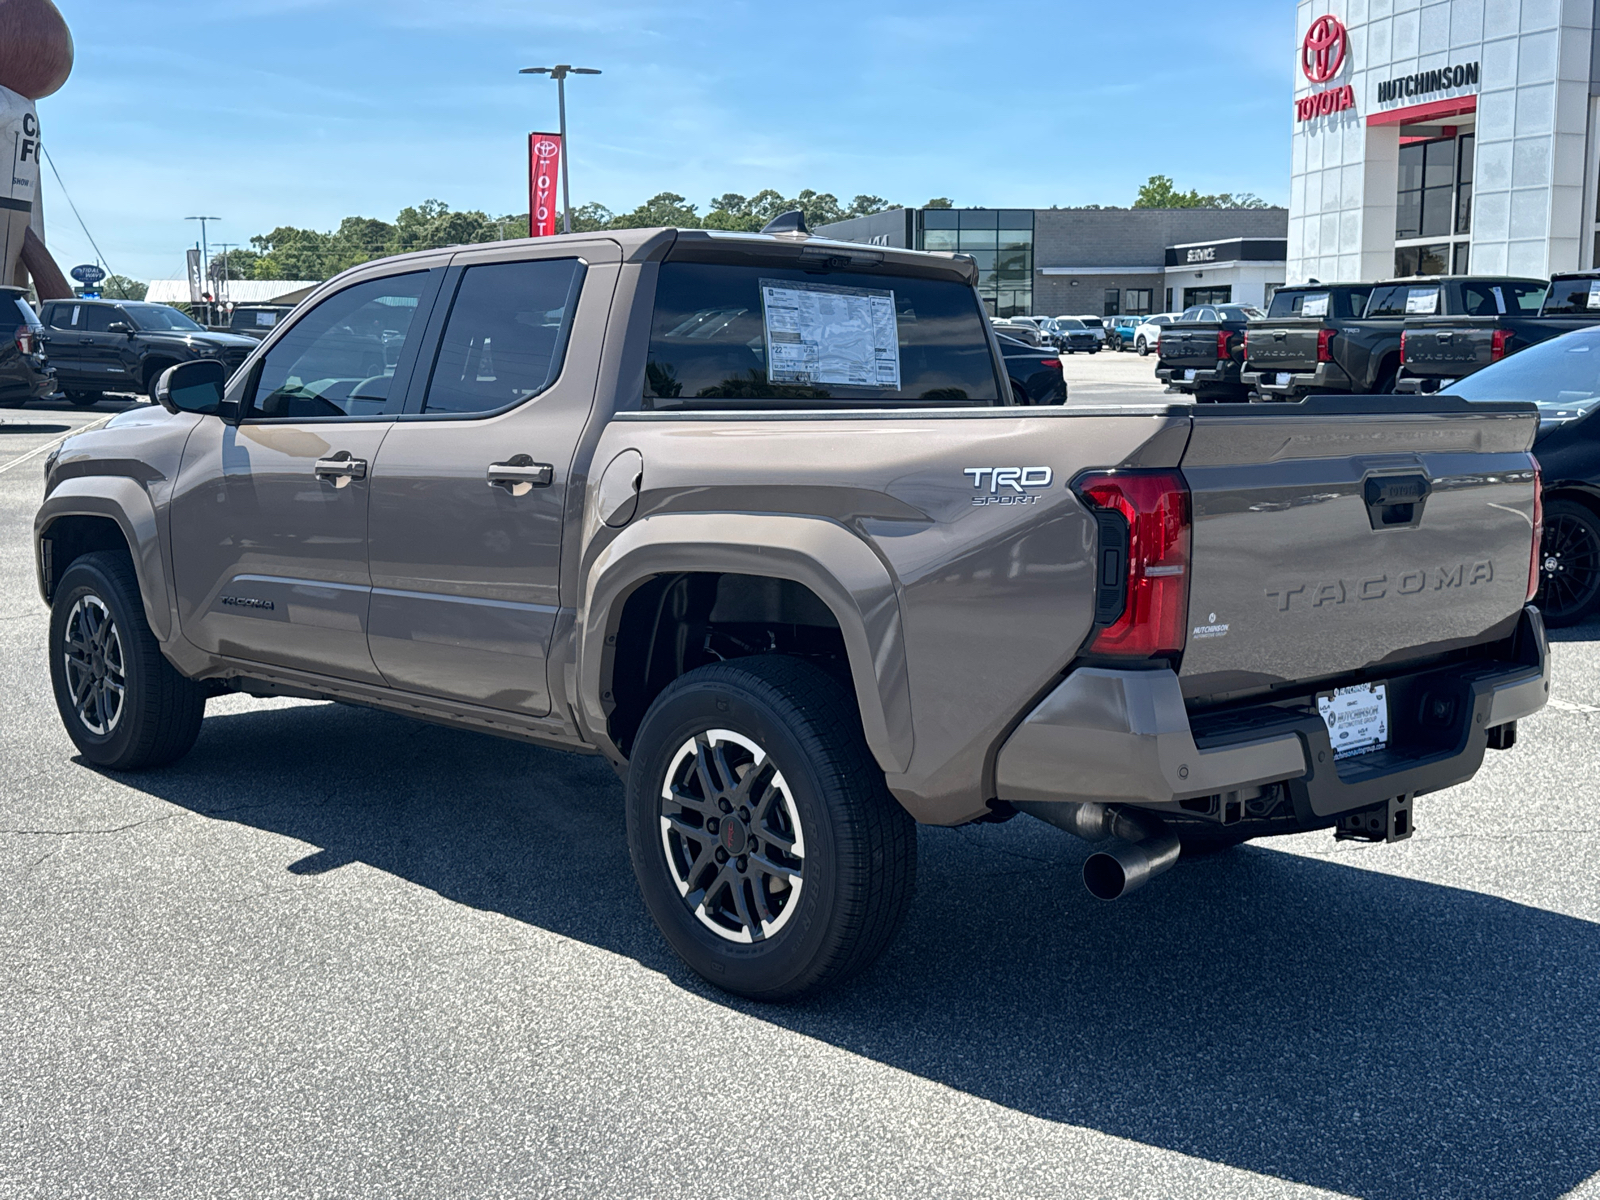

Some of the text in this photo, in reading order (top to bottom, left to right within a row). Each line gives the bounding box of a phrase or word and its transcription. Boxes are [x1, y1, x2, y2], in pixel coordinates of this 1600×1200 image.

[1378, 61, 1479, 103] HUTCHINSON
[1295, 84, 1354, 123] TOYOTA
[1187, 247, 1216, 262] SERVICE
[963, 466, 1053, 494] TRD
[1389, 484, 1417, 497] TOYOTA
[971, 495, 1042, 506] SPORT
[1267, 560, 1494, 611] TACOMA
[221, 595, 275, 610] TACOMA
[1193, 624, 1230, 634] HUTCHINSON
[1337, 705, 1379, 723] HUTCHINSON
[727, 820, 735, 848] TRD
[802, 802, 821, 931] GRABBER
